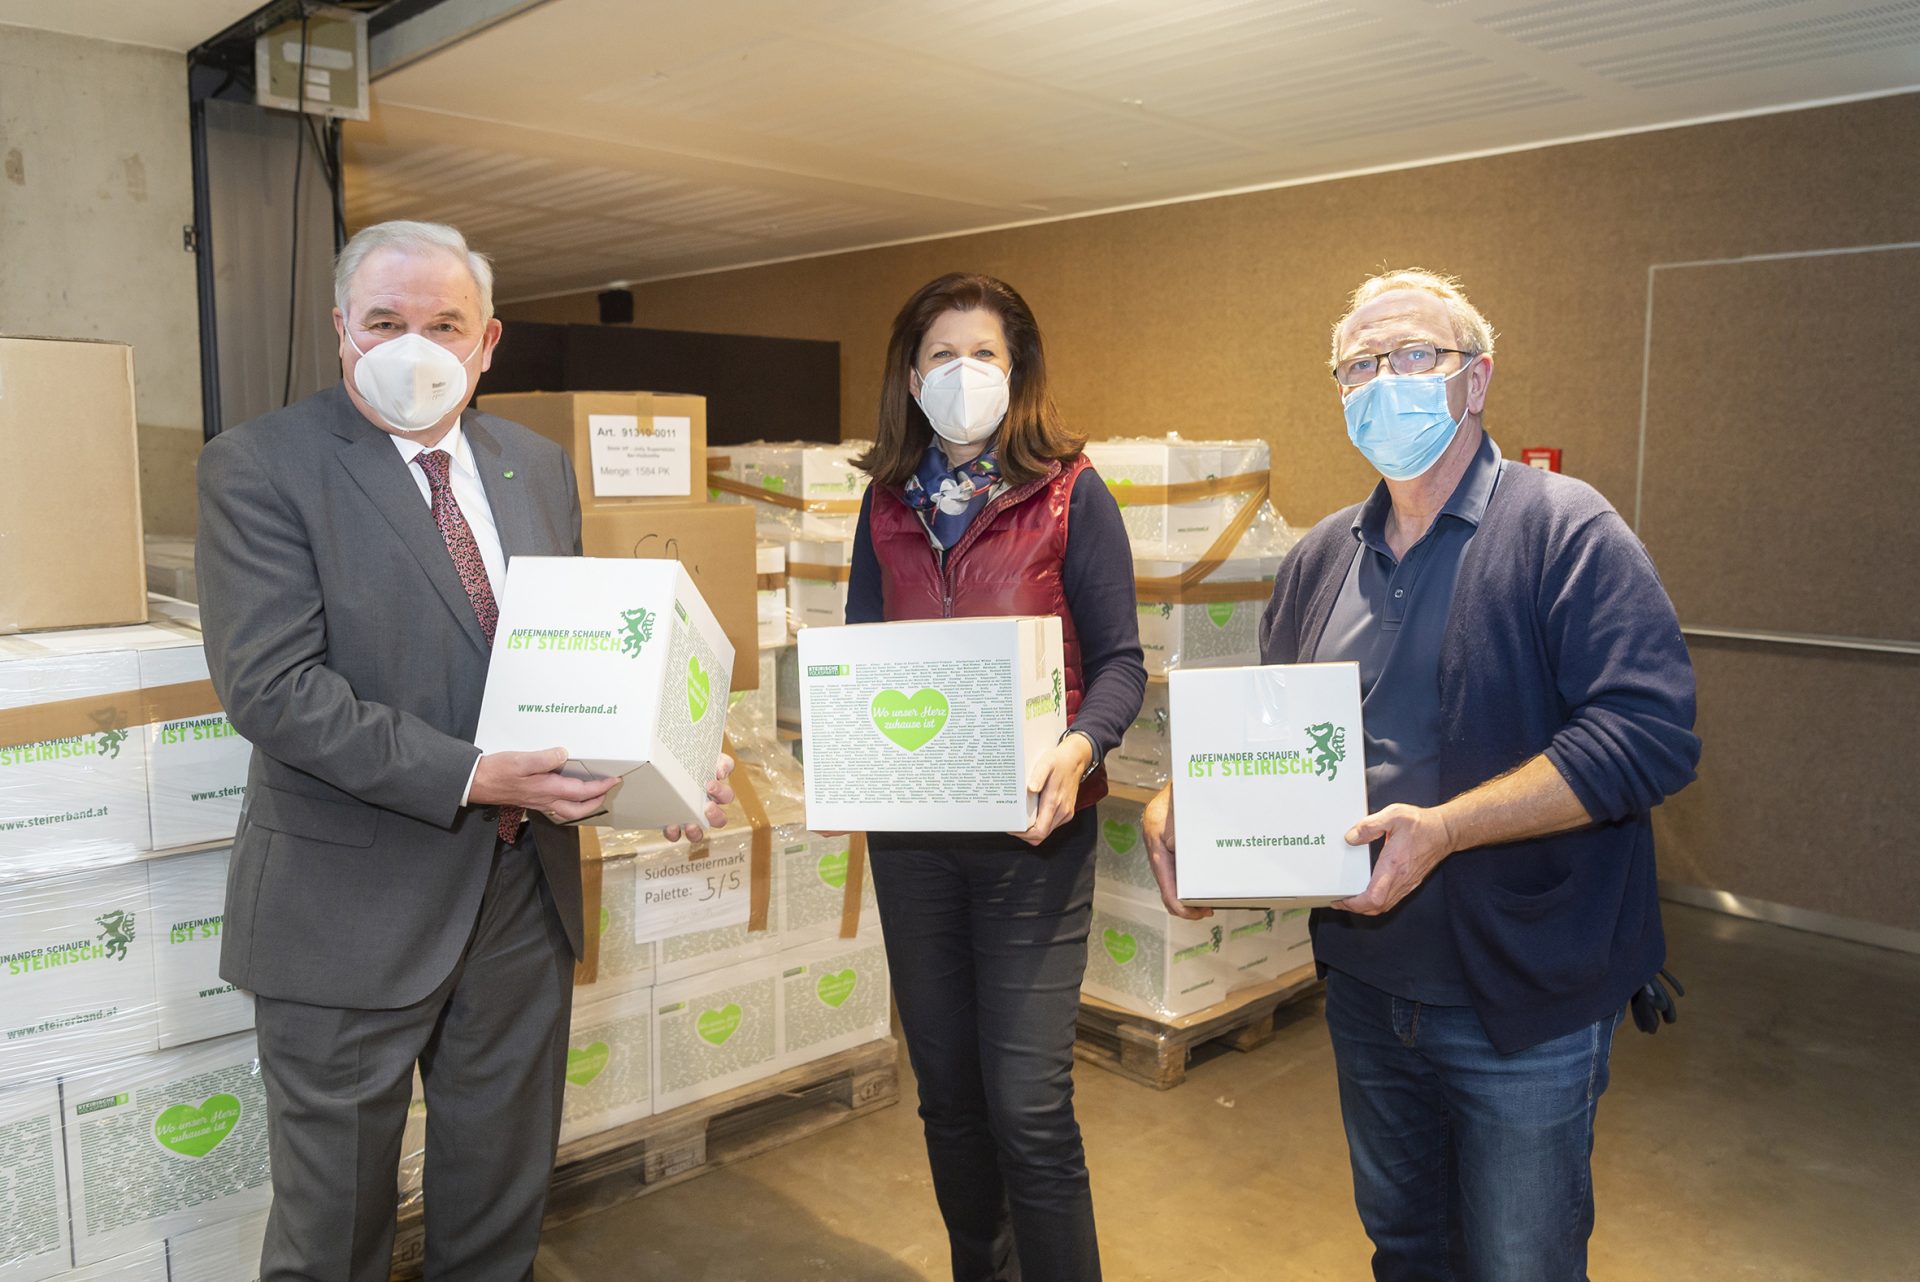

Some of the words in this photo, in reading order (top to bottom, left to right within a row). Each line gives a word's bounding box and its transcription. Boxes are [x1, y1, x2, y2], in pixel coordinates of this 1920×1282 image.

[597, 427, 616, 437] Art.
[658, 466, 671, 476] PK
[511, 628, 570, 639] AUFEINANDER
[572, 629, 612, 639] SCHAUEN
[507, 635, 531, 650] IST
[537, 636, 622, 652] STEIRISCH
[517, 703, 618, 715] www.steirerband.at
[873, 706, 890, 718] Wo
[891, 707, 918, 718] unser
[920, 705, 947, 718] Herz
[163, 717, 223, 731] AUFEINANDER
[884, 719, 921, 730] zuhause
[923, 718, 936, 729] ist
[39, 735, 83, 748] SCHAUEN
[161, 728, 187, 745] IST
[1, 740, 97, 766] STEIRISCH
[1189, 752, 1254, 763] AUFEINANDER
[1256, 750, 1300, 761] SCHAUEN
[1187, 760, 1216, 778] IST
[1221, 757, 1313, 776] STEIRISCH
[1215, 833, 1326, 849] www.steirerband.at
[644, 887, 693, 905] Palette:
[698, 869, 741, 902] 5/5
[170, 927, 195, 945] IST
[46, 939, 91, 955] SCHAUEN
[8, 943, 105, 976] STEIRISCH
